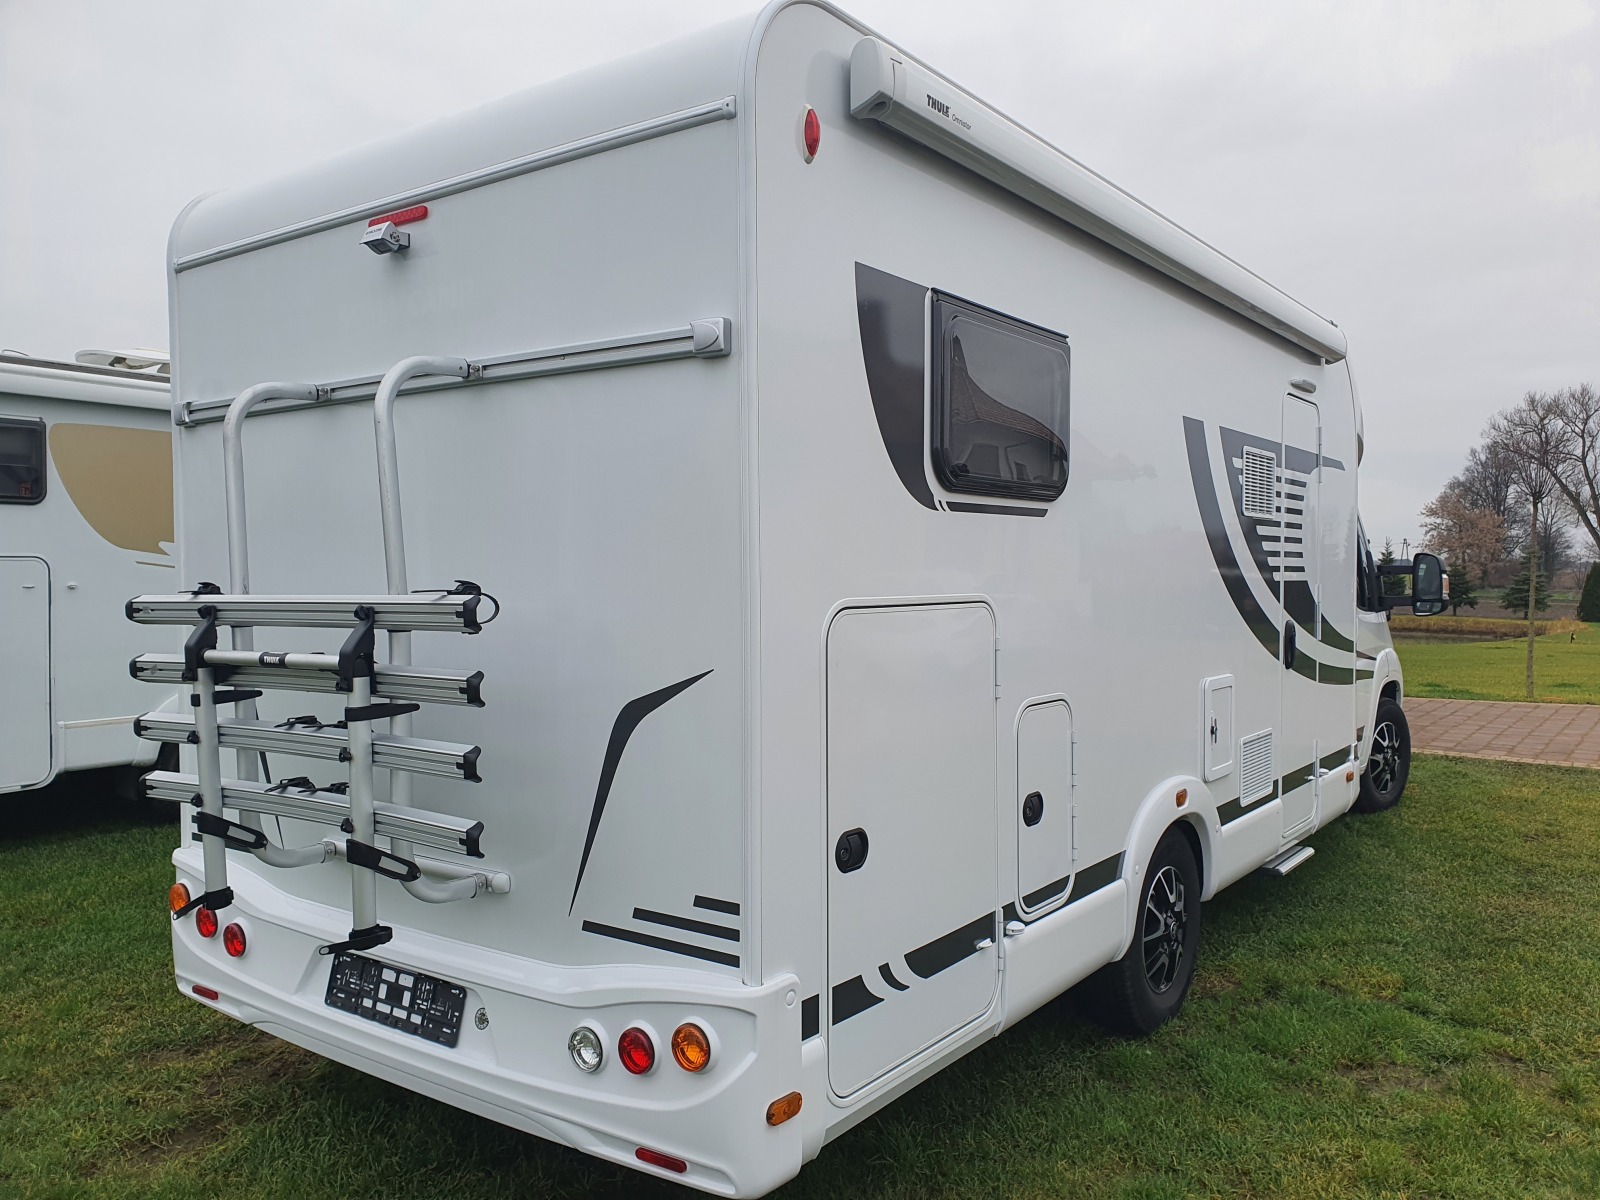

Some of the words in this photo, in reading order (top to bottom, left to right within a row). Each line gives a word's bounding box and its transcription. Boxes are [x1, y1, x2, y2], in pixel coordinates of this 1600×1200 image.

[926, 93, 950, 118] THULE
[951, 113, 972, 130] Omnistor
[263, 655, 280, 664] THULE
